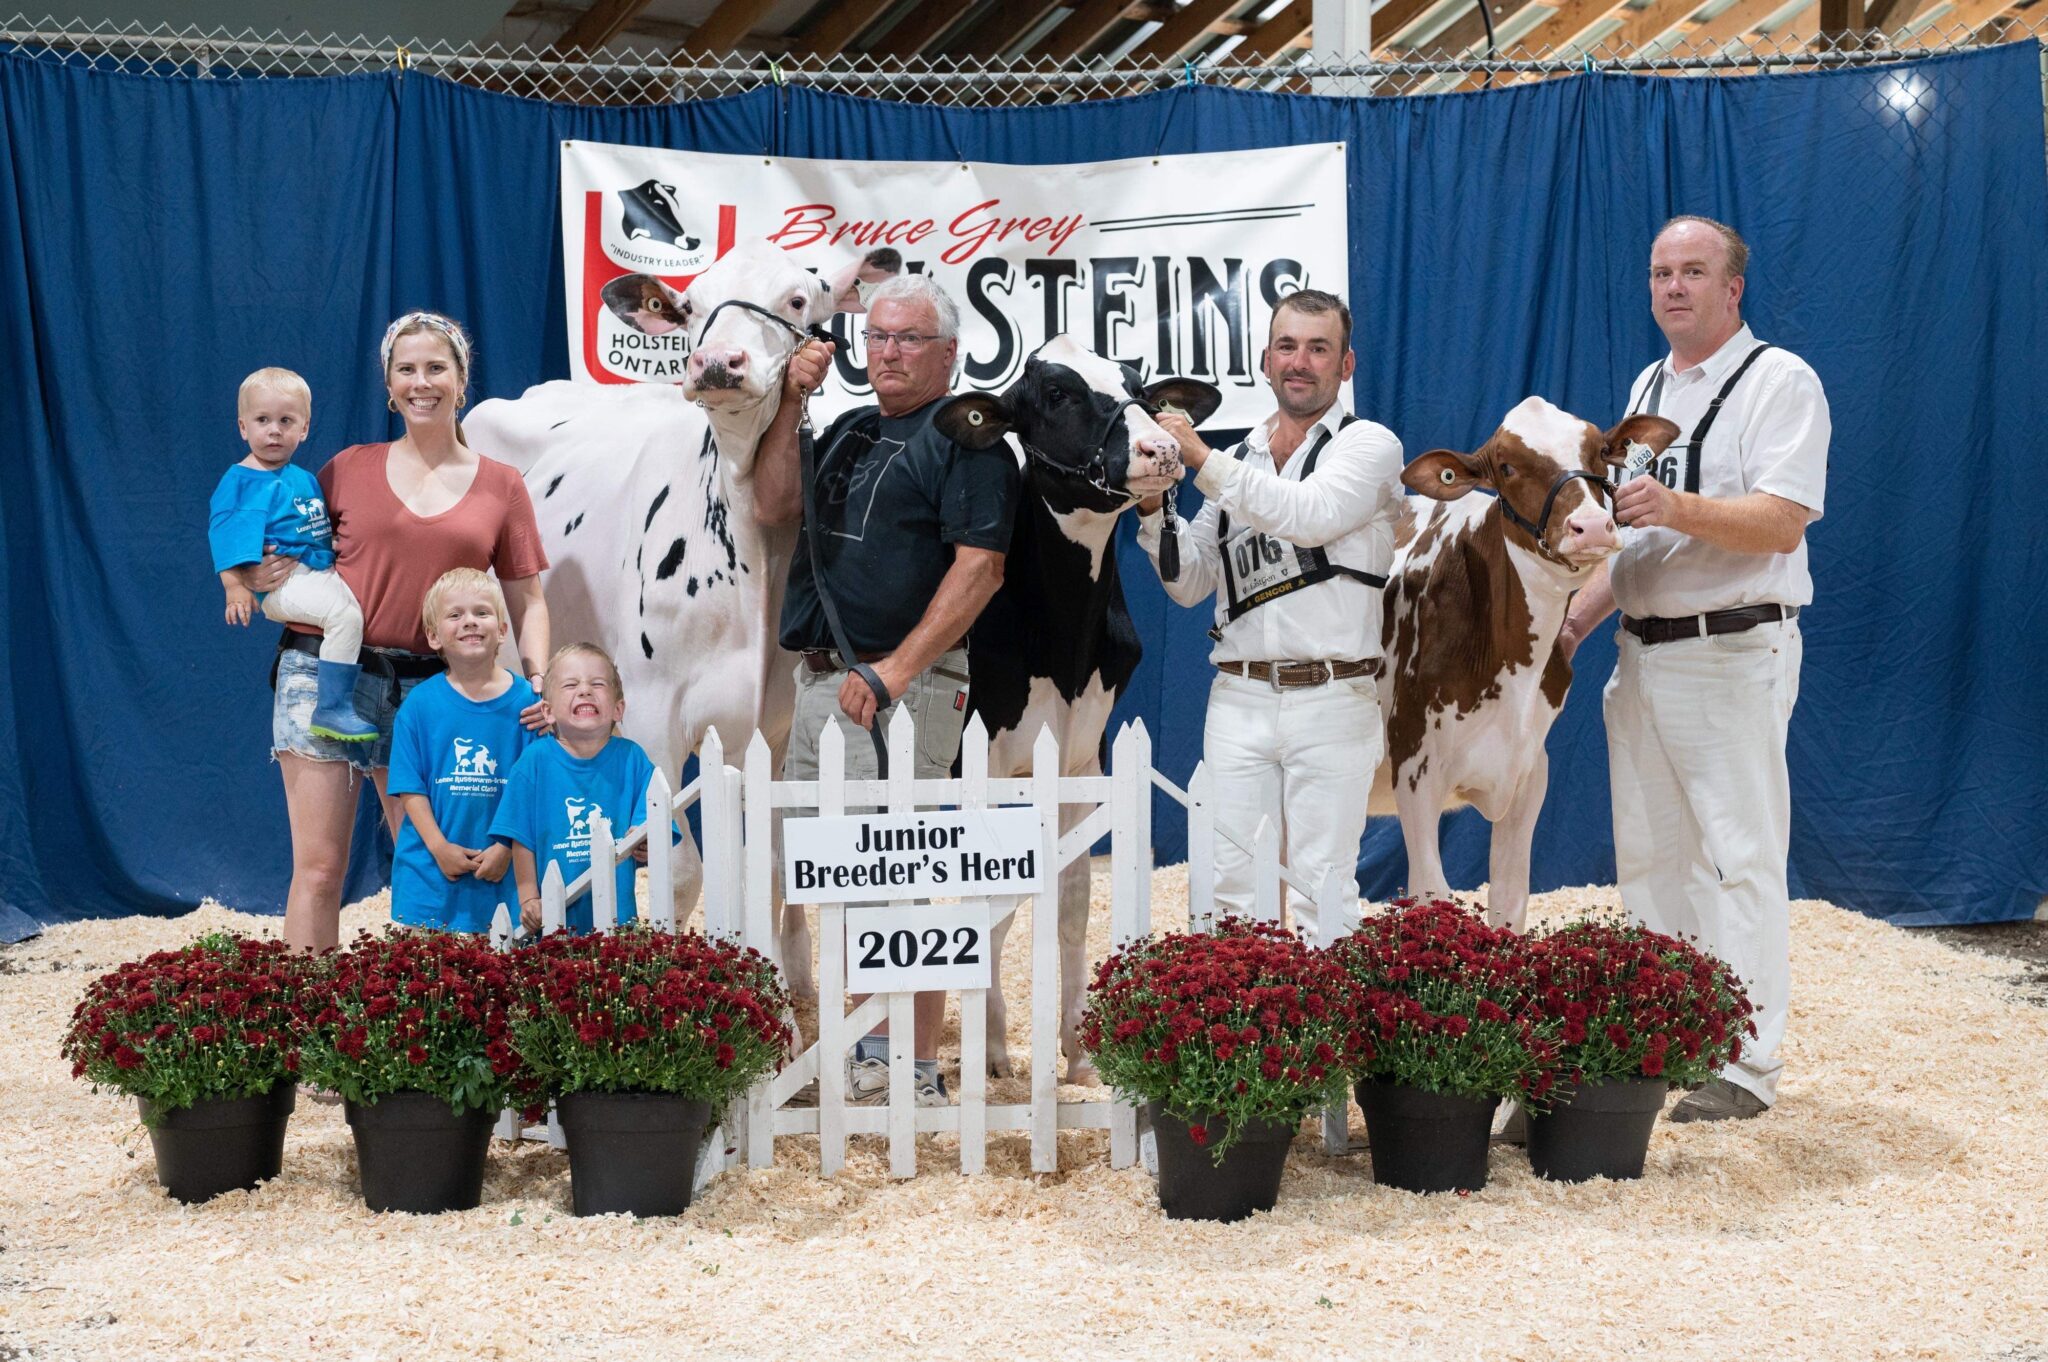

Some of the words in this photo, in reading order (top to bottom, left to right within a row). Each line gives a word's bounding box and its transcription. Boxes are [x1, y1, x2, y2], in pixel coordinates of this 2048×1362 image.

[765, 204, 938, 250] Bruce
[941, 198, 1087, 265] Grey
[612, 333, 691, 352] HOLSTEI
[608, 350, 688, 375] ONTAR
[1633, 449, 1652, 467] 1030
[1235, 532, 1283, 579] 076
[1254, 582, 1293, 603] GENCOR
[856, 820, 965, 853] Junior
[795, 854, 948, 889] Breeder's
[960, 850, 1035, 882] Herd
[859, 927, 980, 969] 2022
